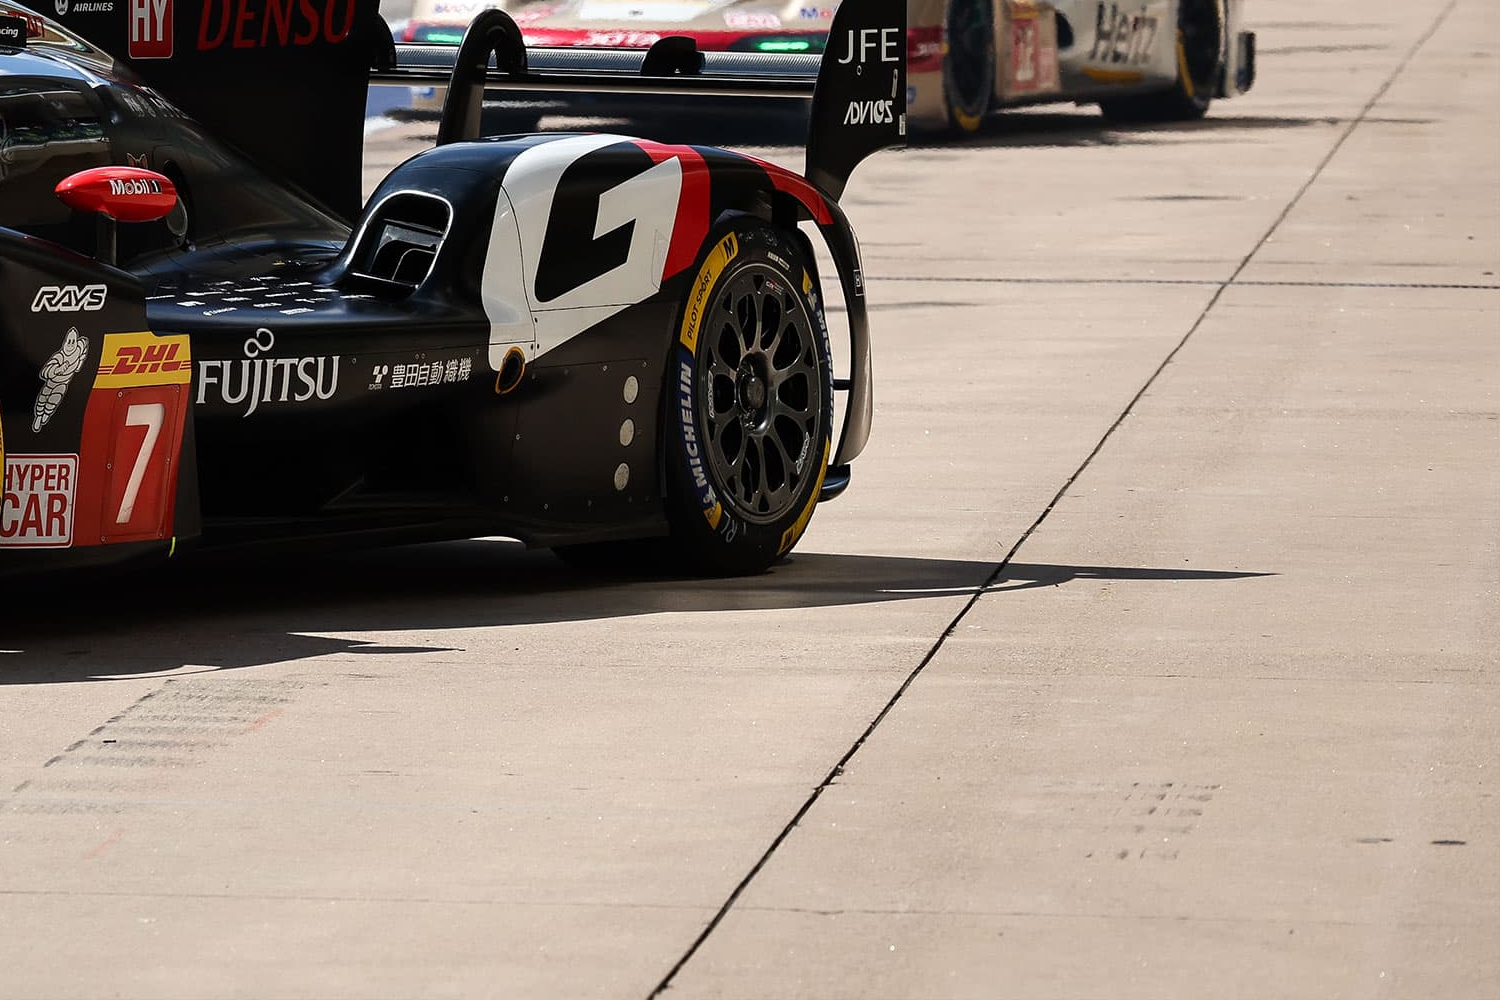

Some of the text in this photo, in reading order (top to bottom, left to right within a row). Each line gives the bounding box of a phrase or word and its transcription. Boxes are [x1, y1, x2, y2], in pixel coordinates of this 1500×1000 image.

[73, 2, 114, 14] AIRLINES
[838, 28, 899, 64] JFE
[1093, 0, 1158, 65] Hertz
[109, 180, 150, 196] Mobil
[723, 239, 735, 259] M
[31, 284, 108, 312] RAYS
[687, 269, 713, 340] PILOT SPORT
[113, 343, 182, 375] DHL
[389, 357, 473, 389] 豊田自動織機
[195, 355, 341, 418] FUJITSU
[679, 361, 708, 488] MICHELIN
[4, 464, 70, 490] HYPER
[116, 404, 165, 524] 7
[1, 492, 68, 540] CAR
